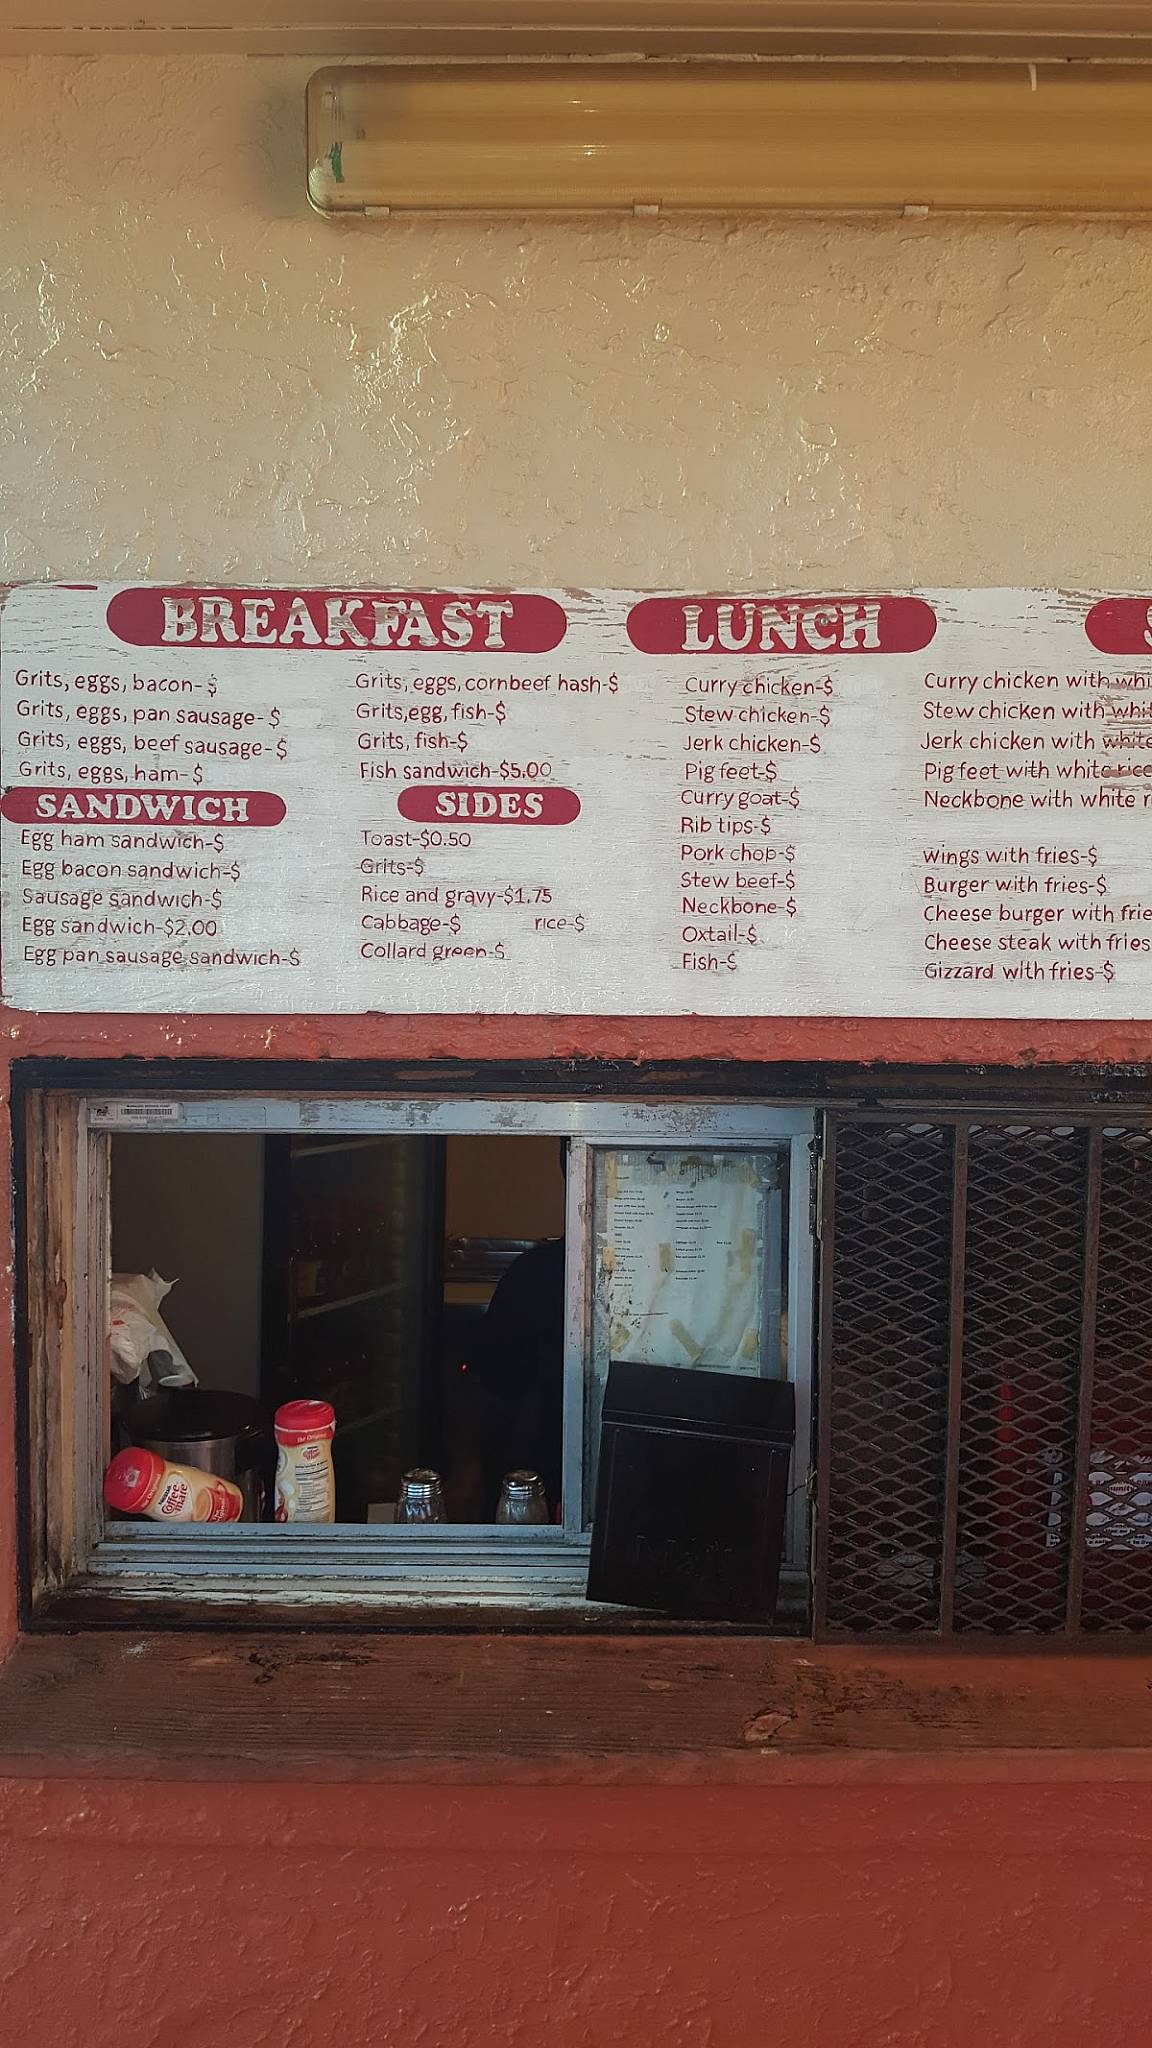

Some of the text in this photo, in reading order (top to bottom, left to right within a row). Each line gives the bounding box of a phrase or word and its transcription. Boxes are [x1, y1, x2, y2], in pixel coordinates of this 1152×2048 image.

[161, 596, 515, 649] BREAKFAST
[681, 602, 881, 650] LUNCH
[15, 669, 70, 692] Grits,
[74, 673, 126, 694] eggs,
[355, 673, 408, 693] Grits,
[413, 676, 461, 695] eggs,
[465, 673, 552, 692] cornbeef
[685, 676, 834, 697] Curry chicken-$
[924, 672, 979, 695] Curry
[983, 671, 1058, 689] chicken
[1066, 671, 1110, 689] with
[16, 699, 70, 721] Grits,
[76, 705, 127, 725] eggs,
[133, 709, 170, 725] pan
[451, 700, 506, 725] fish-$
[685, 705, 831, 728] Stew chicken-$
[923, 701, 974, 719] Stew
[979, 700, 1055, 720] chicken
[1062, 700, 1105, 719] with
[18, 730, 70, 751] Grits,
[78, 735, 127, 755] eggs,
[134, 734, 181, 752] beef
[358, 731, 468, 752] Grits, fish-$
[683, 733, 821, 754] Jerk chicken-$
[920, 729, 962, 750] Jerk
[969, 730, 1045, 750] chicken
[1052, 731, 1095, 750] with
[19, 761, 71, 781] Grits,
[78, 765, 128, 784] eggs,
[360, 762, 397, 780] Fish
[685, 760, 714, 784] Pig
[924, 761, 954, 783] Pig
[958, 761, 1000, 779] feet
[1007, 759, 1050, 779] with
[36, 793, 249, 822] SANDWICH
[435, 792, 543, 818] SIDES
[681, 789, 734, 810] Curry
[924, 789, 1024, 810] Neckbone
[1031, 790, 1073, 808] with
[1081, 786, 1135, 807] white
[681, 817, 712, 834] Rib
[20, 829, 55, 851] Egg
[61, 830, 104, 847] ham
[360, 829, 471, 850] Toast-$0.50
[681, 844, 724, 862] Pork
[986, 846, 1029, 864] with
[1035, 844, 1098, 867] fries-$
[22, 859, 55, 880] Egg
[62, 860, 122, 877] bacon
[681, 871, 729, 888] Stew
[361, 886, 399, 903] Rice
[406, 887, 438, 903] and
[924, 876, 989, 897] Burger
[995, 876, 1038, 893] with
[22, 888, 103, 910] Sausage
[924, 905, 992, 922] Cheese
[1000, 904, 1064, 926] burger
[1072, 902, 1114, 923] with
[22, 917, 56, 936] Egg
[360, 942, 426, 960] Collard
[924, 933, 992, 951] Cheese
[998, 933, 1051, 951] steak
[1058, 932, 1101, 951] with
[24, 945, 56, 965] Egg
[63, 949, 99, 965] pan
[106, 950, 183, 968] sausage
[925, 961, 993, 979] Gizzard
[1003, 960, 1045, 980] with
